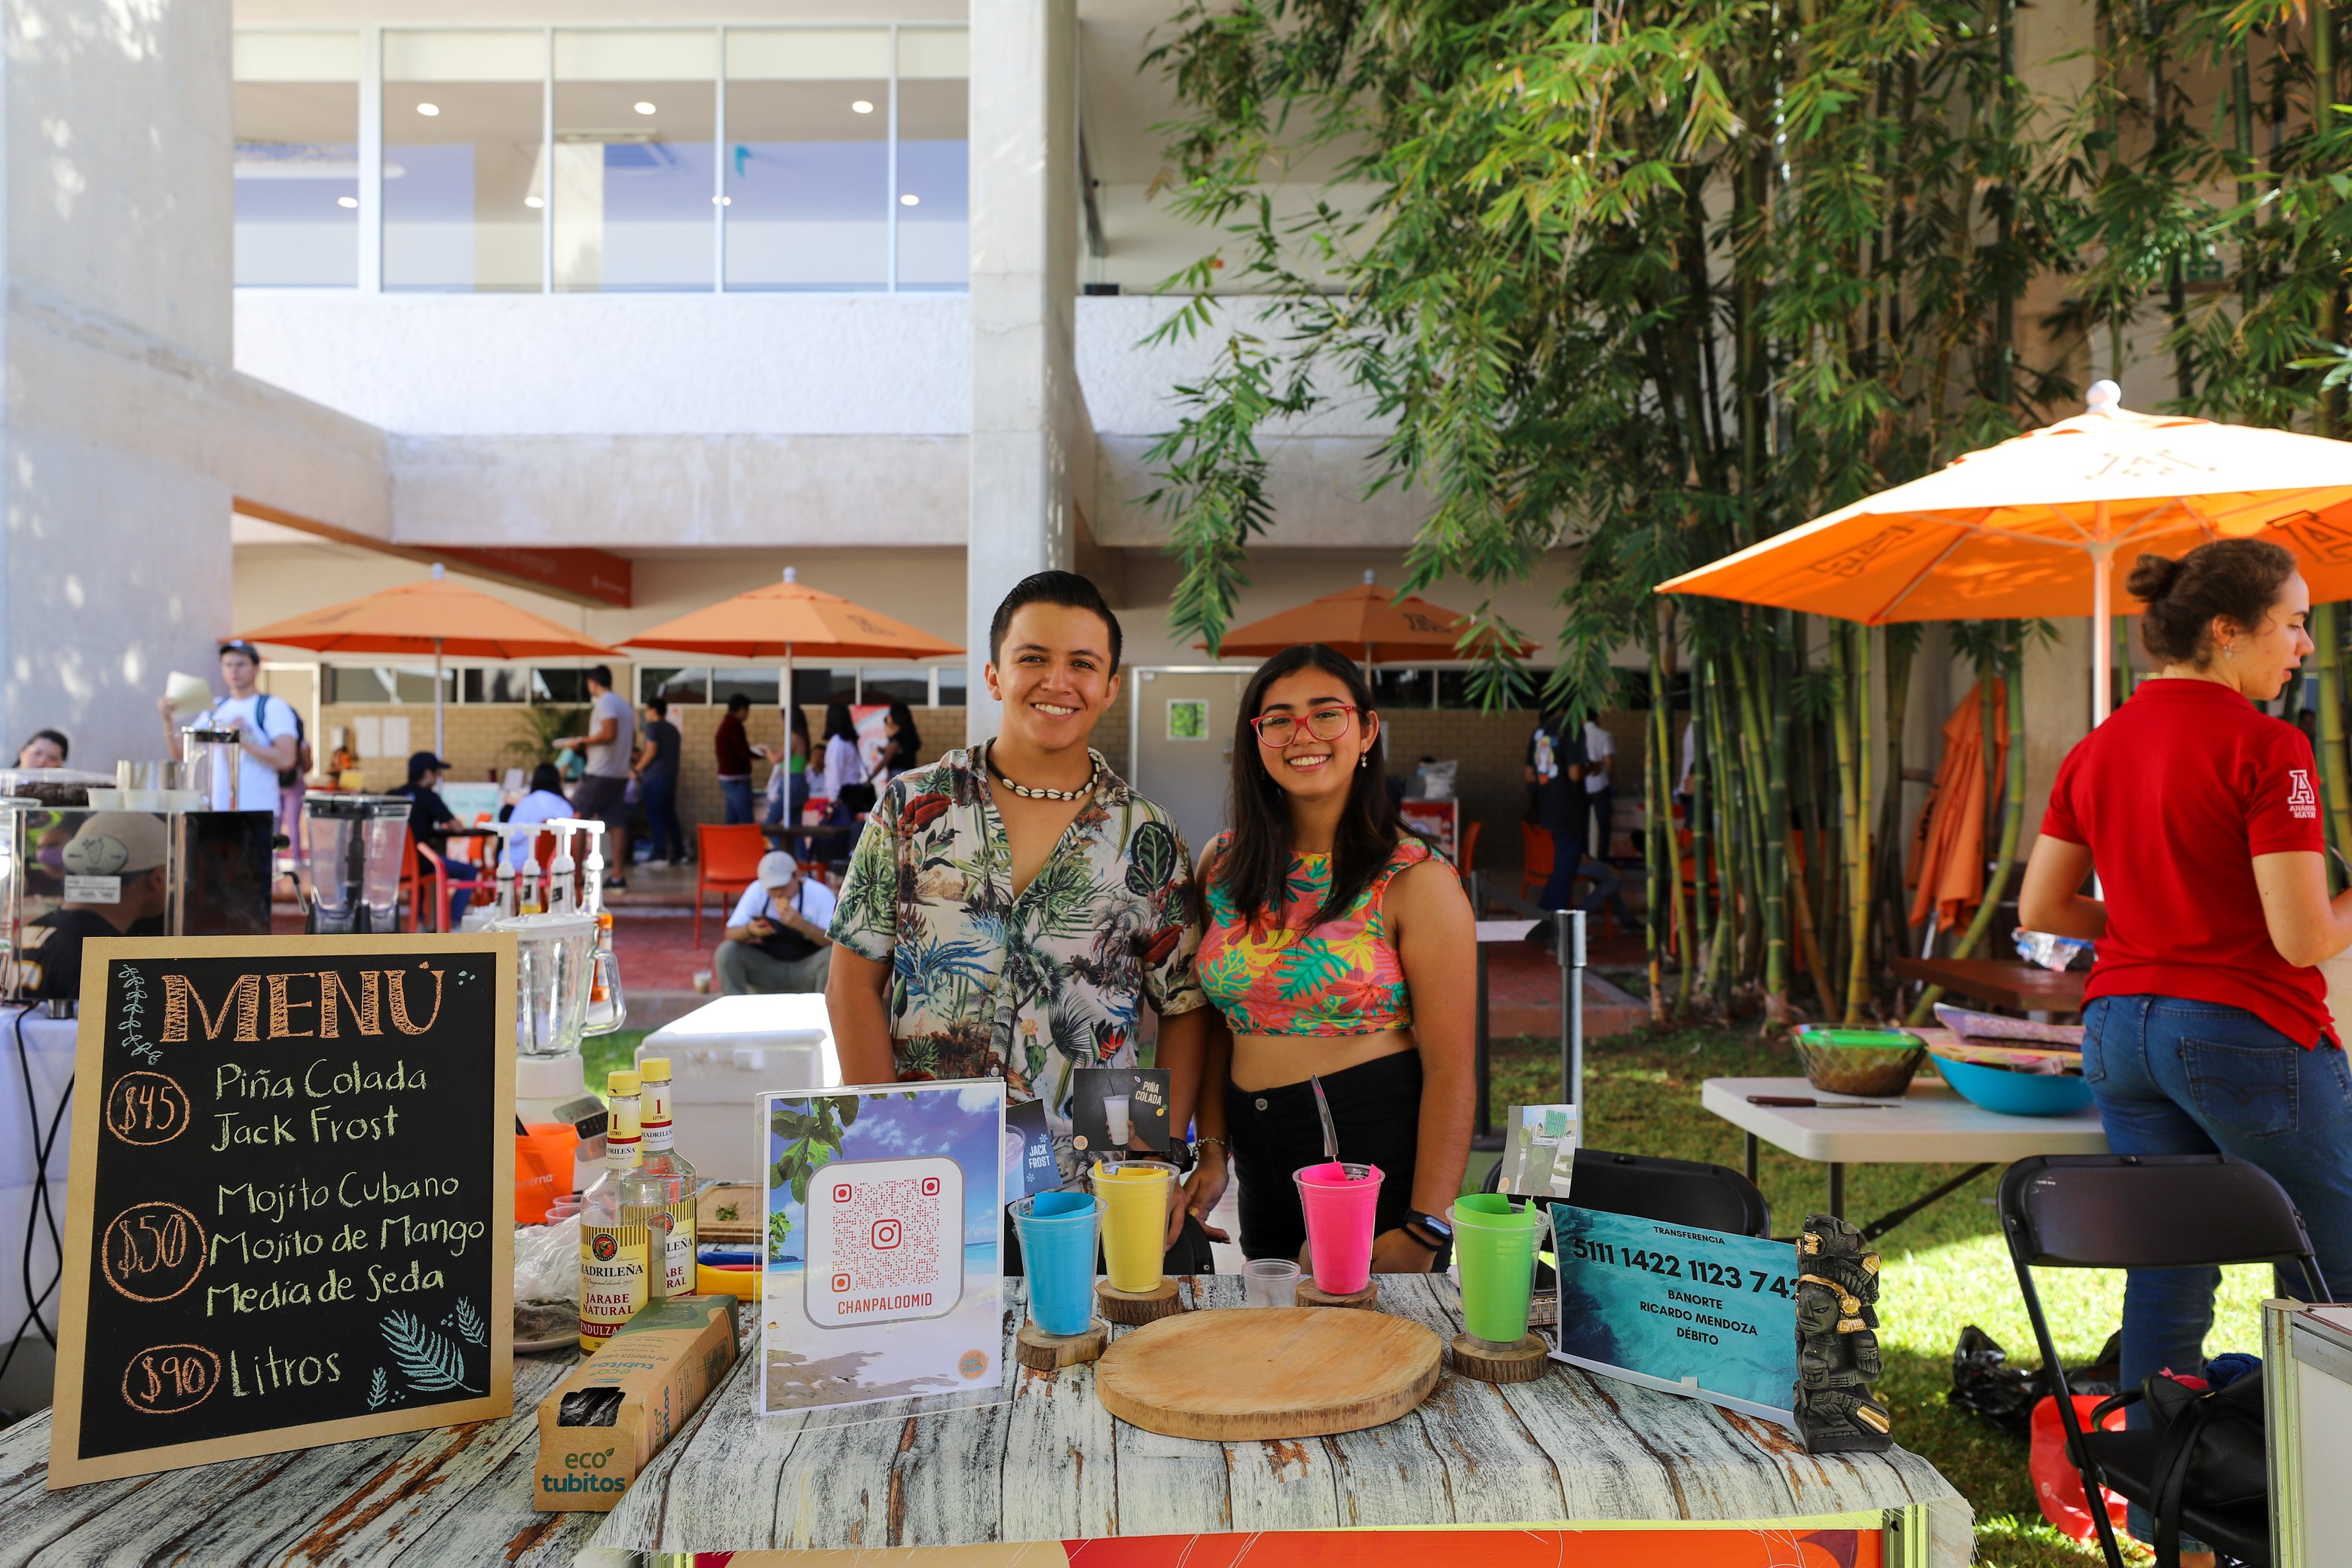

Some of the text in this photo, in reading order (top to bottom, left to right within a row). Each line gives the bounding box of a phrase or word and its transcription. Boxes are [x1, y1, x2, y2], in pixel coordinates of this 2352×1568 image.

[216, 1058, 427, 1100] Piña Colada
[1143, 1080, 1160, 1094] PIÑA
[656, 1099, 662, 1114] 1
[1135, 1090, 1162, 1106] COLADA
[120, 1086, 176, 1135] $45
[1546, 1110, 1567, 1125] MOJITO
[210, 1104, 399, 1152] Jack Frost
[613, 1114, 618, 1130] 1
[1544, 1122, 1566, 1138] CUBANO
[642, 1129, 673, 1138] MADRILEÑ
[607, 1147, 635, 1155] DRILEÑA
[1029, 1144, 1048, 1157] JACK
[1028, 1155, 1051, 1169] FROST
[218, 1171, 459, 1223] Mojito Cubano
[210, 1214, 485, 1267] Mojito de Mango
[1653, 1226, 1726, 1245] TRANSFERENCIA
[117, 1214, 188, 1279] $50
[1573, 1238, 1615, 1264] 5111
[1621, 1247, 1682, 1278] 1422
[1689, 1260, 1742, 1289] 1123
[207, 1259, 445, 1317] Media de Seda
[622, 1279, 634, 1288] 1911
[586, 1292, 629, 1304] JARABE
[838, 1292, 933, 1315] CHANPALOOMID
[1668, 1289, 1723, 1310] BANORTE
[583, 1304, 635, 1316] NATURAL
[1640, 1300, 1758, 1336] RICARDO MENDOZA
[1677, 1326, 1719, 1346] DÉBITO
[140, 1346, 341, 1403] $90 Litros
[588, 1361, 654, 1370] tubitos
[565, 1451, 608, 1469] eco
[541, 1472, 626, 1493] tubitos
